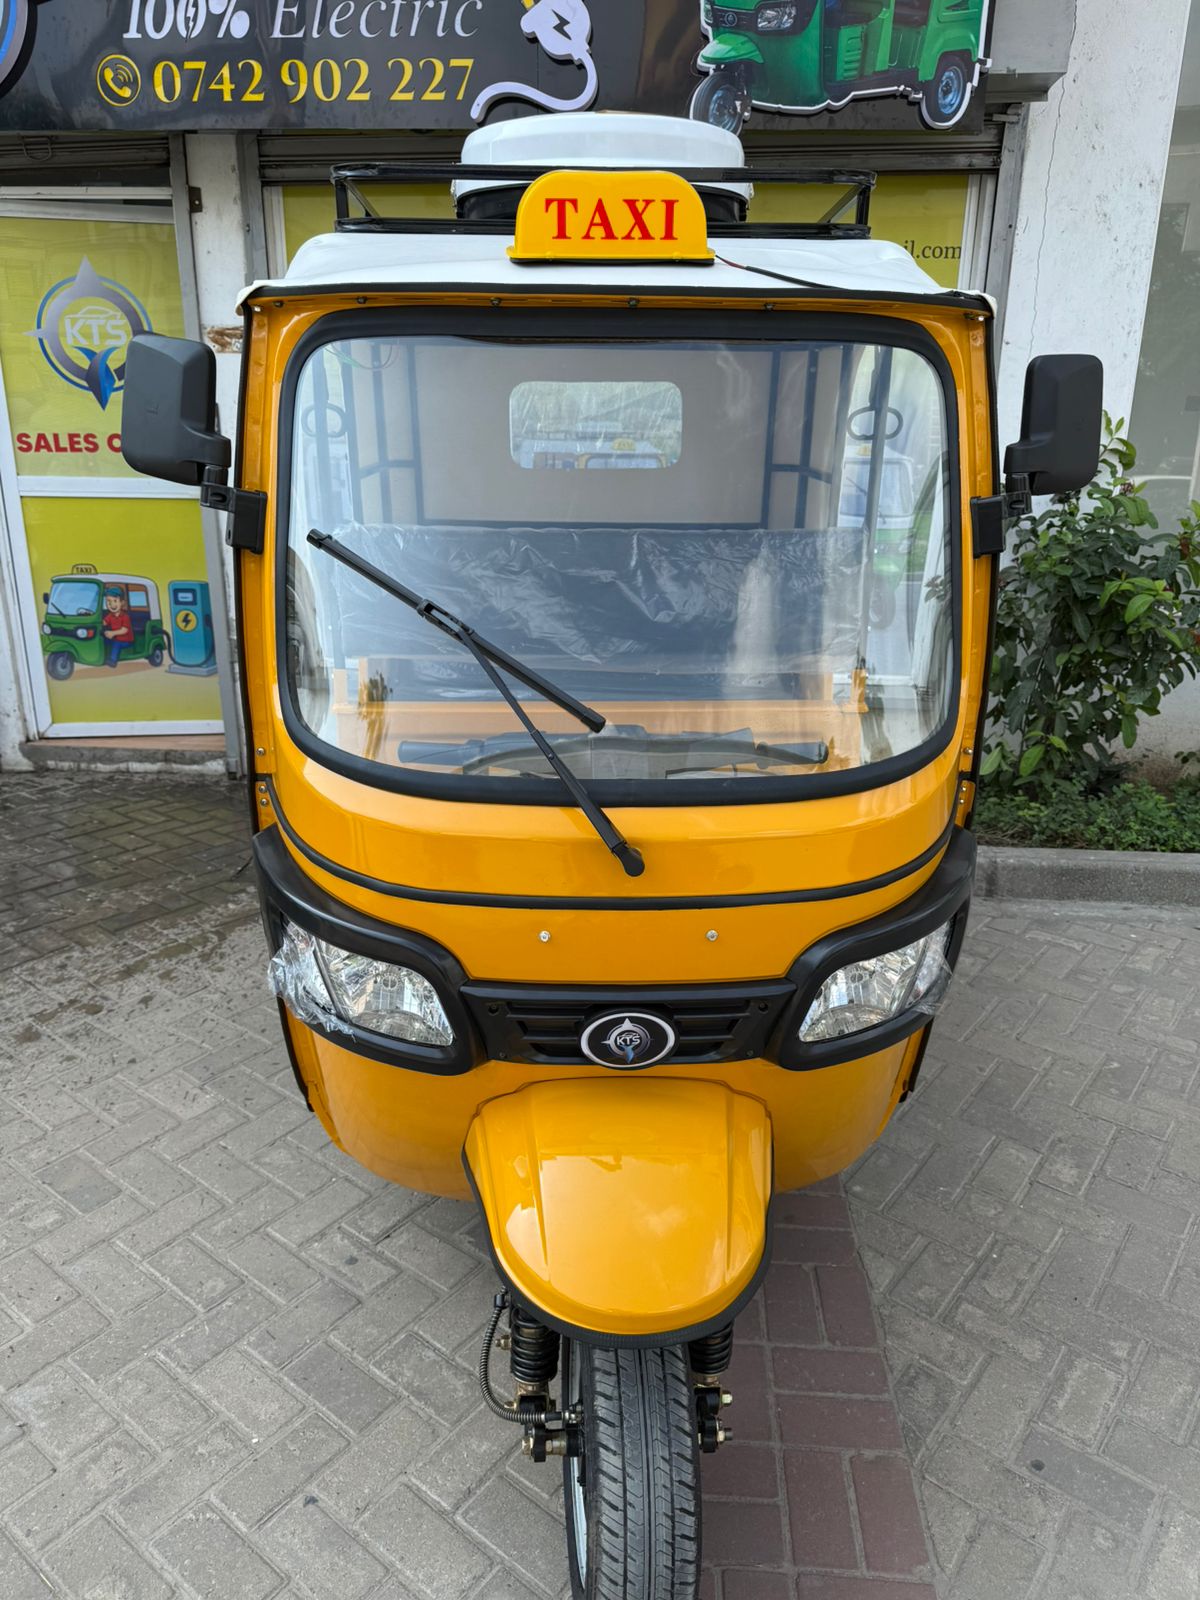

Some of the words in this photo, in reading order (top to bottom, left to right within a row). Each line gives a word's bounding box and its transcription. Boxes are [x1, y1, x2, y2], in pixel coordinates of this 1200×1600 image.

[122, 0, 250, 39] 100%
[269, 0, 483, 39] Electric
[152, 59, 265, 104] 0742
[280, 58, 371, 104] 902
[387, 58, 475, 101] 227
[545, 198, 679, 241] TAXI
[64, 318, 127, 345] KTS
[16, 433, 100, 453] SALES
[616, 1035, 641, 1046] KTS
